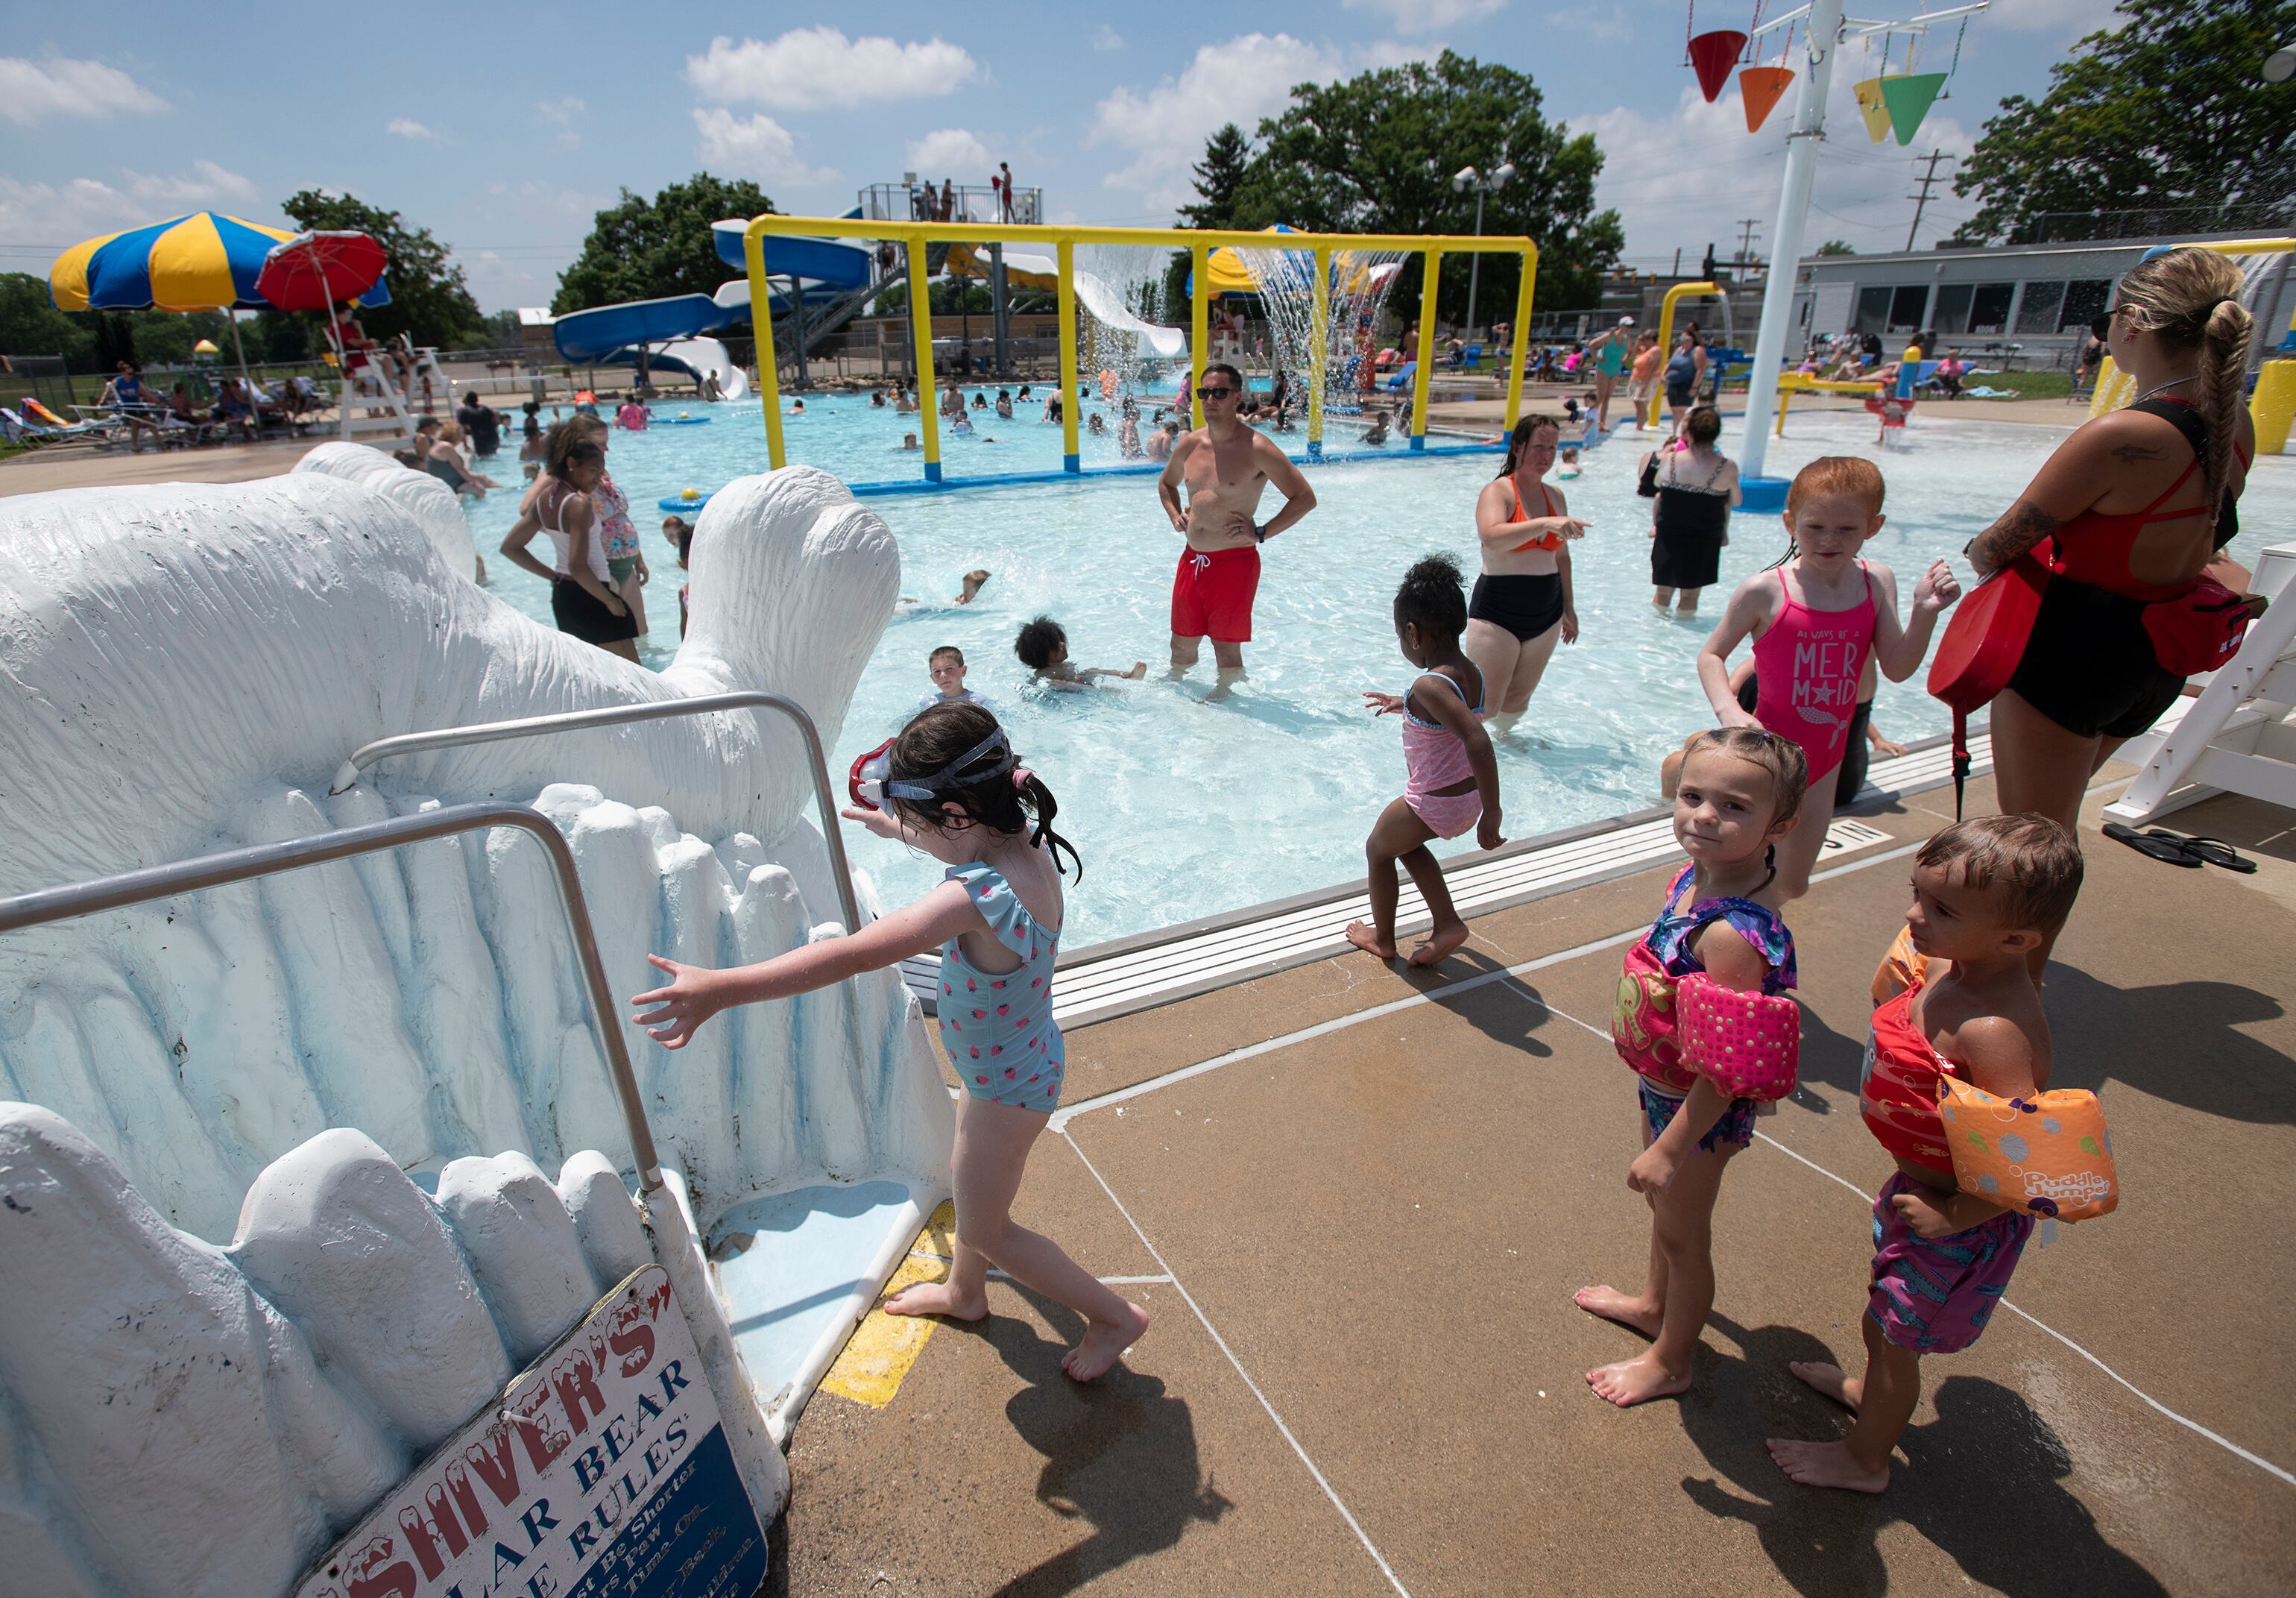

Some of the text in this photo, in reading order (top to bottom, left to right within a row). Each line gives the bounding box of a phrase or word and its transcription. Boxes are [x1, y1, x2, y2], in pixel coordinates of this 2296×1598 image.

[1794, 642, 1858, 679] MER
[2024, 1171, 2103, 1187] Puddle
[2025, 1180, 2110, 1202] Jumper
[569, 1360, 692, 1497] BEAR
[600, 1543, 626, 1575] Be
[631, 1460, 697, 1539] Shorter
[622, 1521, 660, 1573] Paw
[622, 1541, 669, 1598] Time
